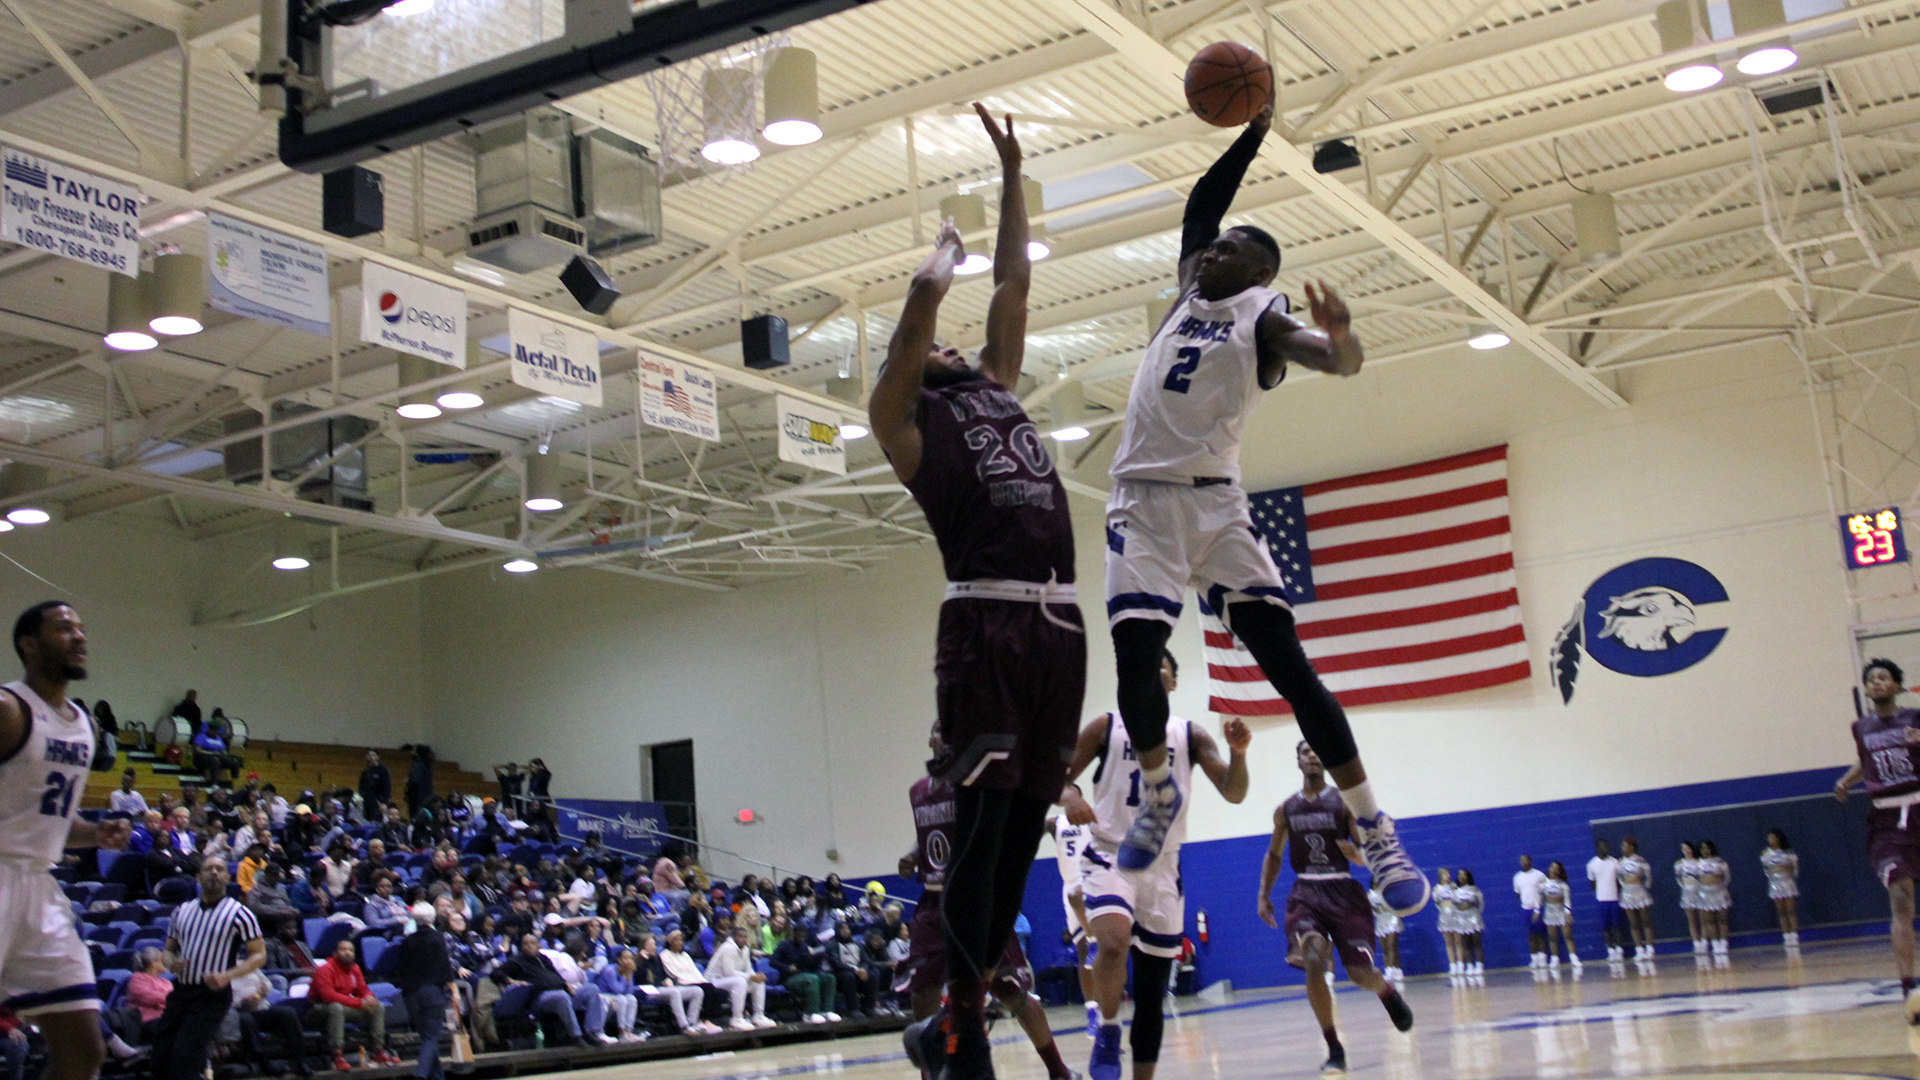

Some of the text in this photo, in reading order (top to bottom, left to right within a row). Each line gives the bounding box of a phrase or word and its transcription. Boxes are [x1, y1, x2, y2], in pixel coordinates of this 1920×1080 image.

[3, 184, 41, 214] Taylor
[42, 196, 87, 227] Freezer
[88, 210, 120, 238] Sales
[51, 174, 138, 218] TAYLOR
[406, 305, 457, 335] pepsi
[515, 342, 558, 371] Metal
[560, 355, 597, 384] Tech
[1163, 346, 1202, 395] 2
[964, 422, 1054, 481] 20
[1853, 529, 1897, 565] 23
[39, 771, 80, 819] 21
[927, 829, 951, 870] 0
[1066, 841, 1076, 857] 5
[1304, 833, 1330, 865] 2
